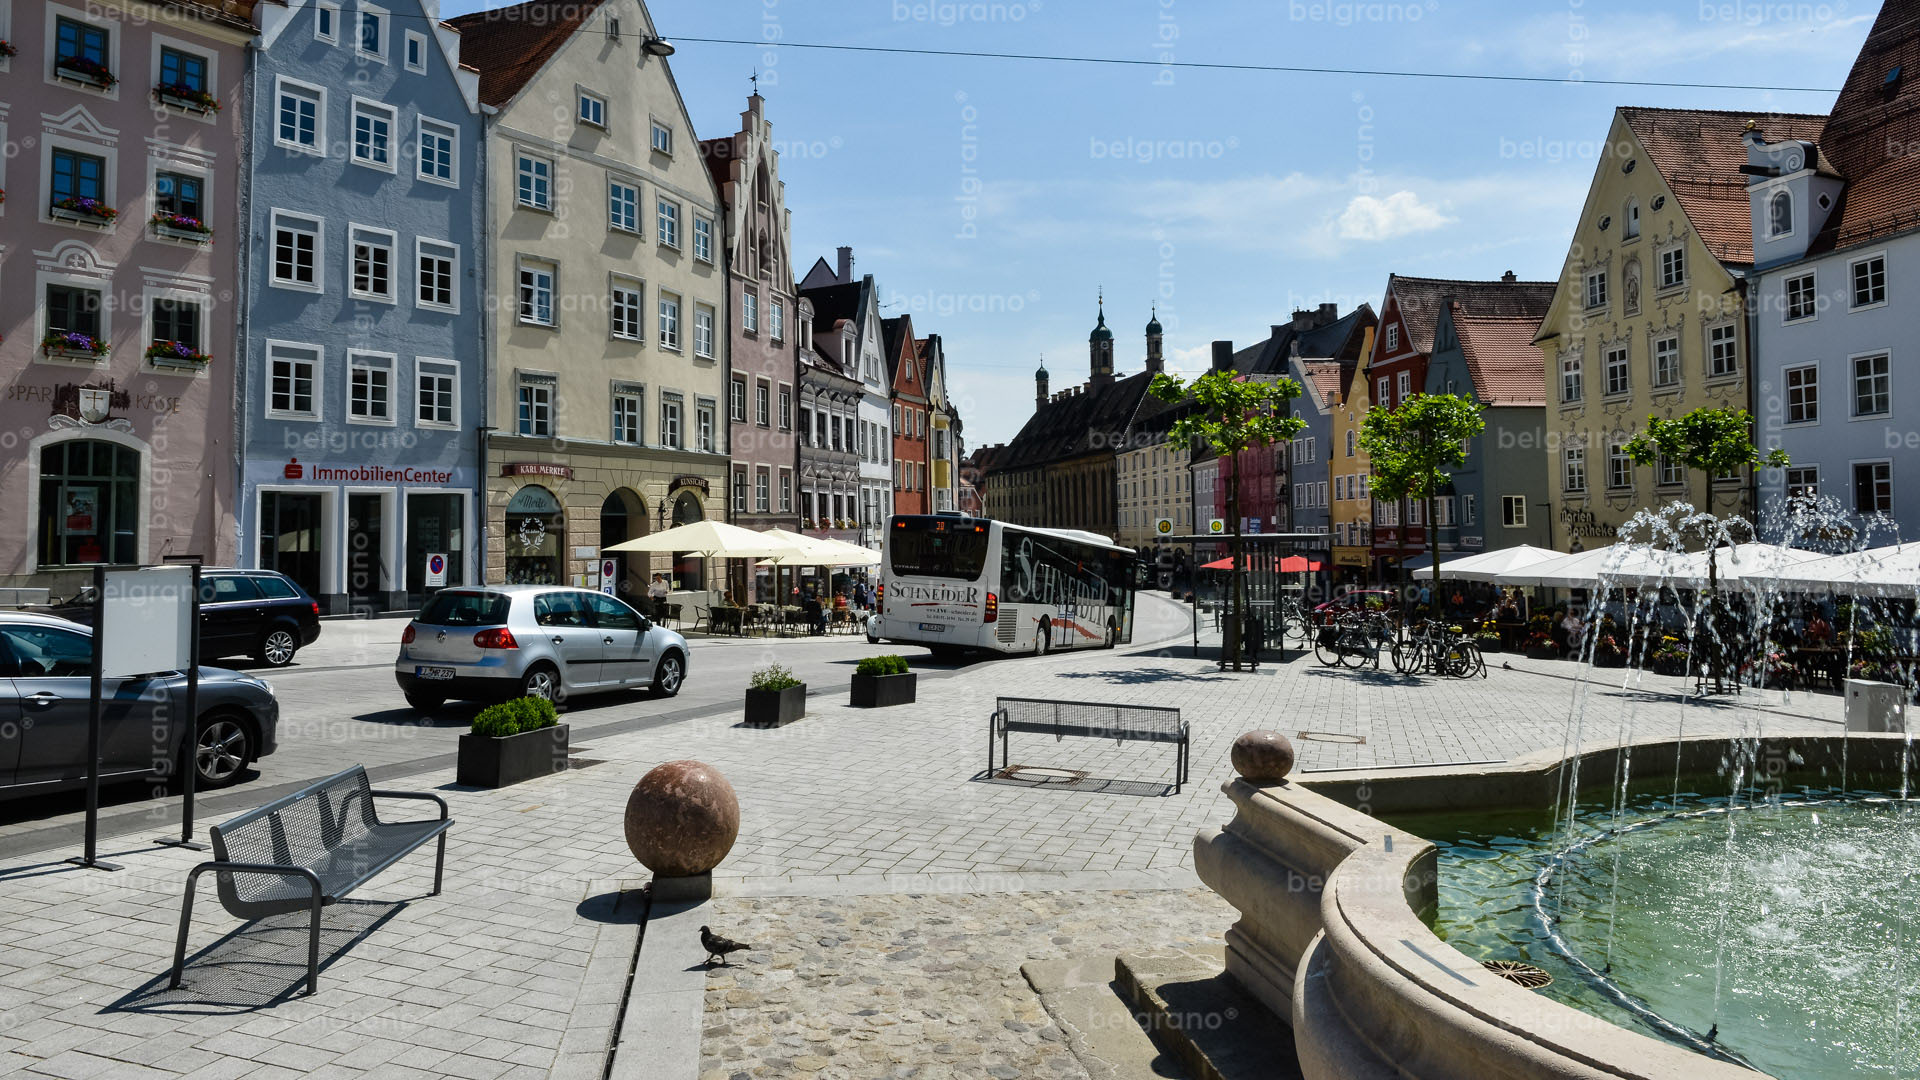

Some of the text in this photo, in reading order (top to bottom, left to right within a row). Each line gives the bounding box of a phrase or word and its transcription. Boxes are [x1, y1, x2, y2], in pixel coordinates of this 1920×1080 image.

[312, 465, 453, 483] ImmobilienCenter
[520, 466, 565, 476] KARL MERKLE
[1561, 509, 1592, 522] Marien
[1569, 524, 1614, 537] Apotheke
